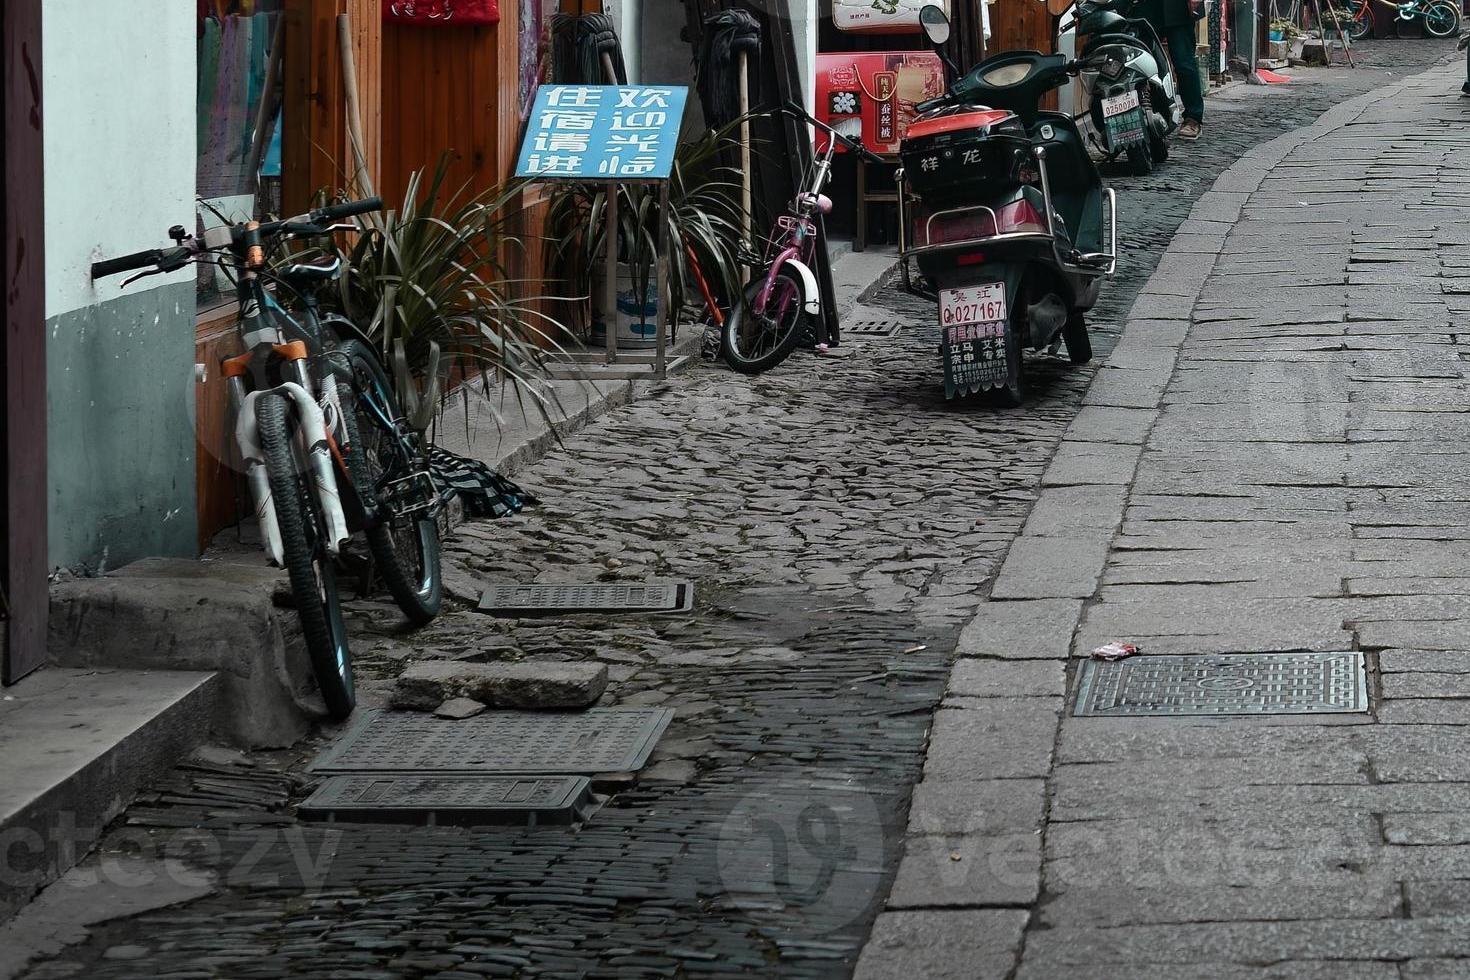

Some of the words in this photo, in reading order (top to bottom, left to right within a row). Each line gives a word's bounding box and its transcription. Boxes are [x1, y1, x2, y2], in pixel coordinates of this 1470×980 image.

[525, 86, 603, 174] 住宿请进
[599, 88, 672, 175] 欢迎光临
